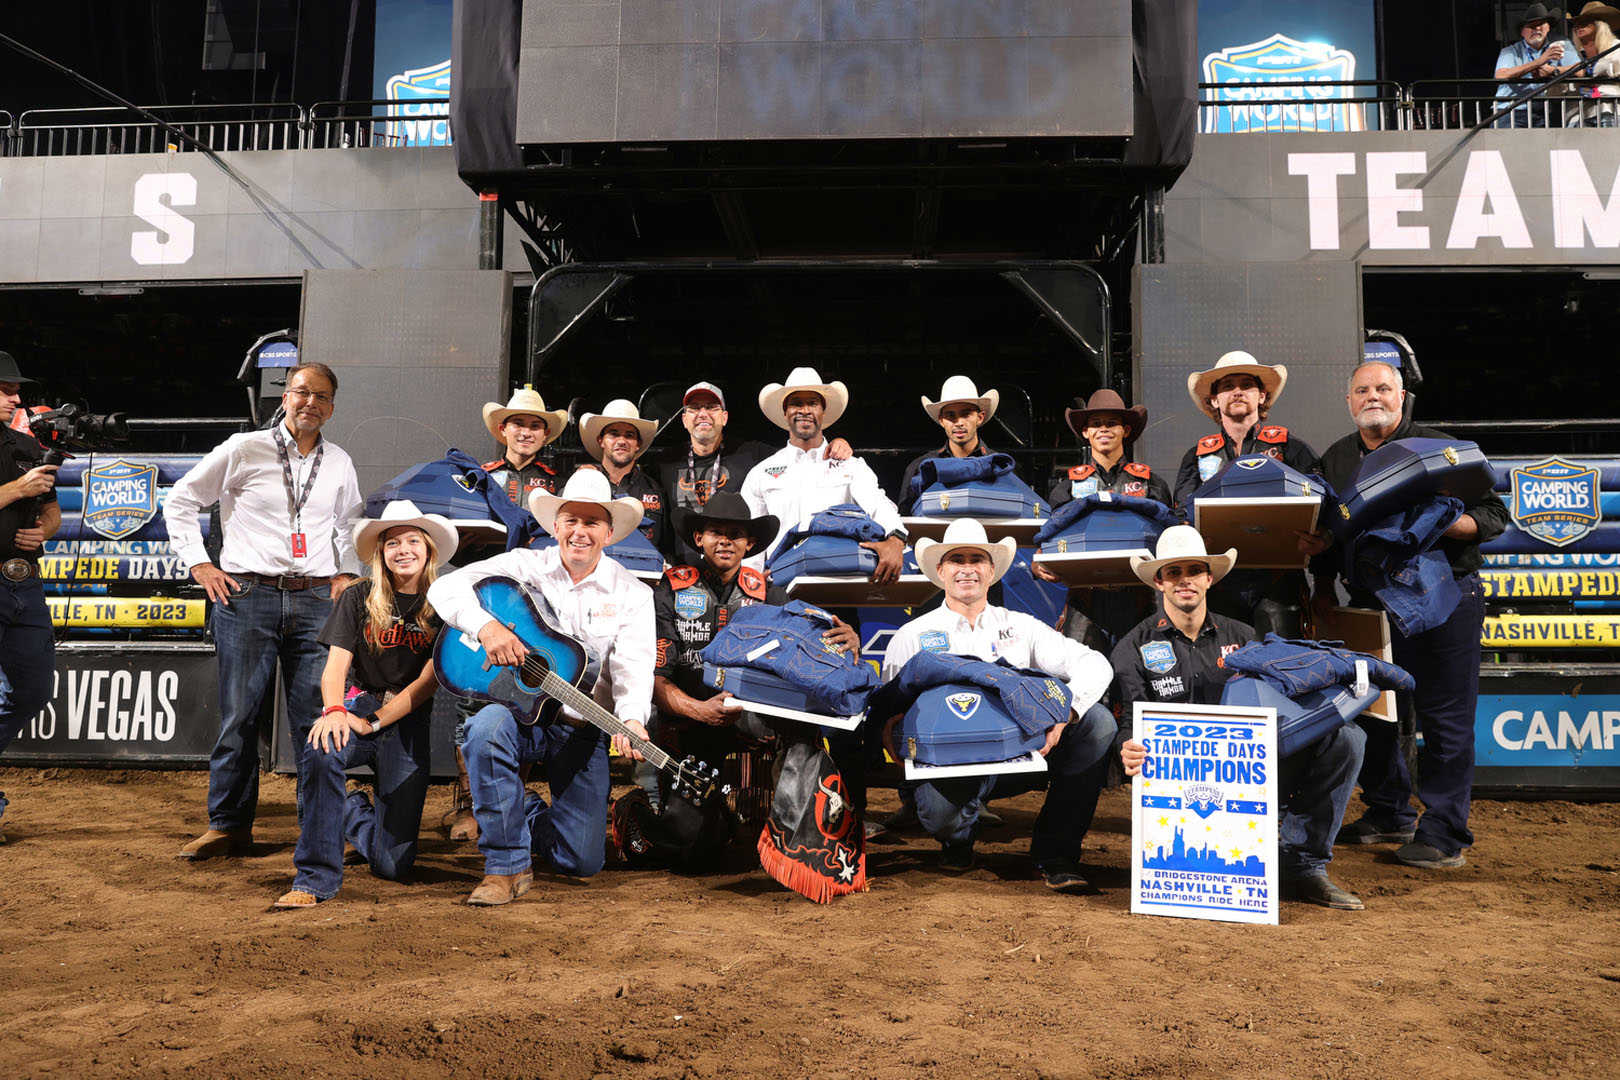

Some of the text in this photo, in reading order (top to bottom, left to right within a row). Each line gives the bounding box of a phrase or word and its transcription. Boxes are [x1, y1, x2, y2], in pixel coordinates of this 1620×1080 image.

[1288, 150, 1620, 249] TEAM
[131, 173, 197, 264] S
[91, 479, 147, 493] CAMPING
[1521, 481, 1589, 494] CAMPING
[91, 491, 147, 507] WORLD
[1522, 494, 1590, 509] WORLD
[1527, 515, 1589, 524] TEAM SERIES
[128, 557, 190, 580] DAYS
[94, 604, 117, 619] TN
[137, 604, 187, 620] 2023
[1481, 623, 1602, 641] NASHVILLE,
[67, 670, 179, 741] VEGAS
[1154, 724, 1254, 740] 2023
[1142, 738, 1267, 759] STAMPEDE DAYS
[1141, 756, 1267, 785] CHAMPIONS
[1154, 871, 1267, 886] BRIDGESTONE ARENA
[1140, 879, 1268, 898] NASHVILLE TN
[1140, 891, 1268, 908] CHAMPIONS RIDE HERE
